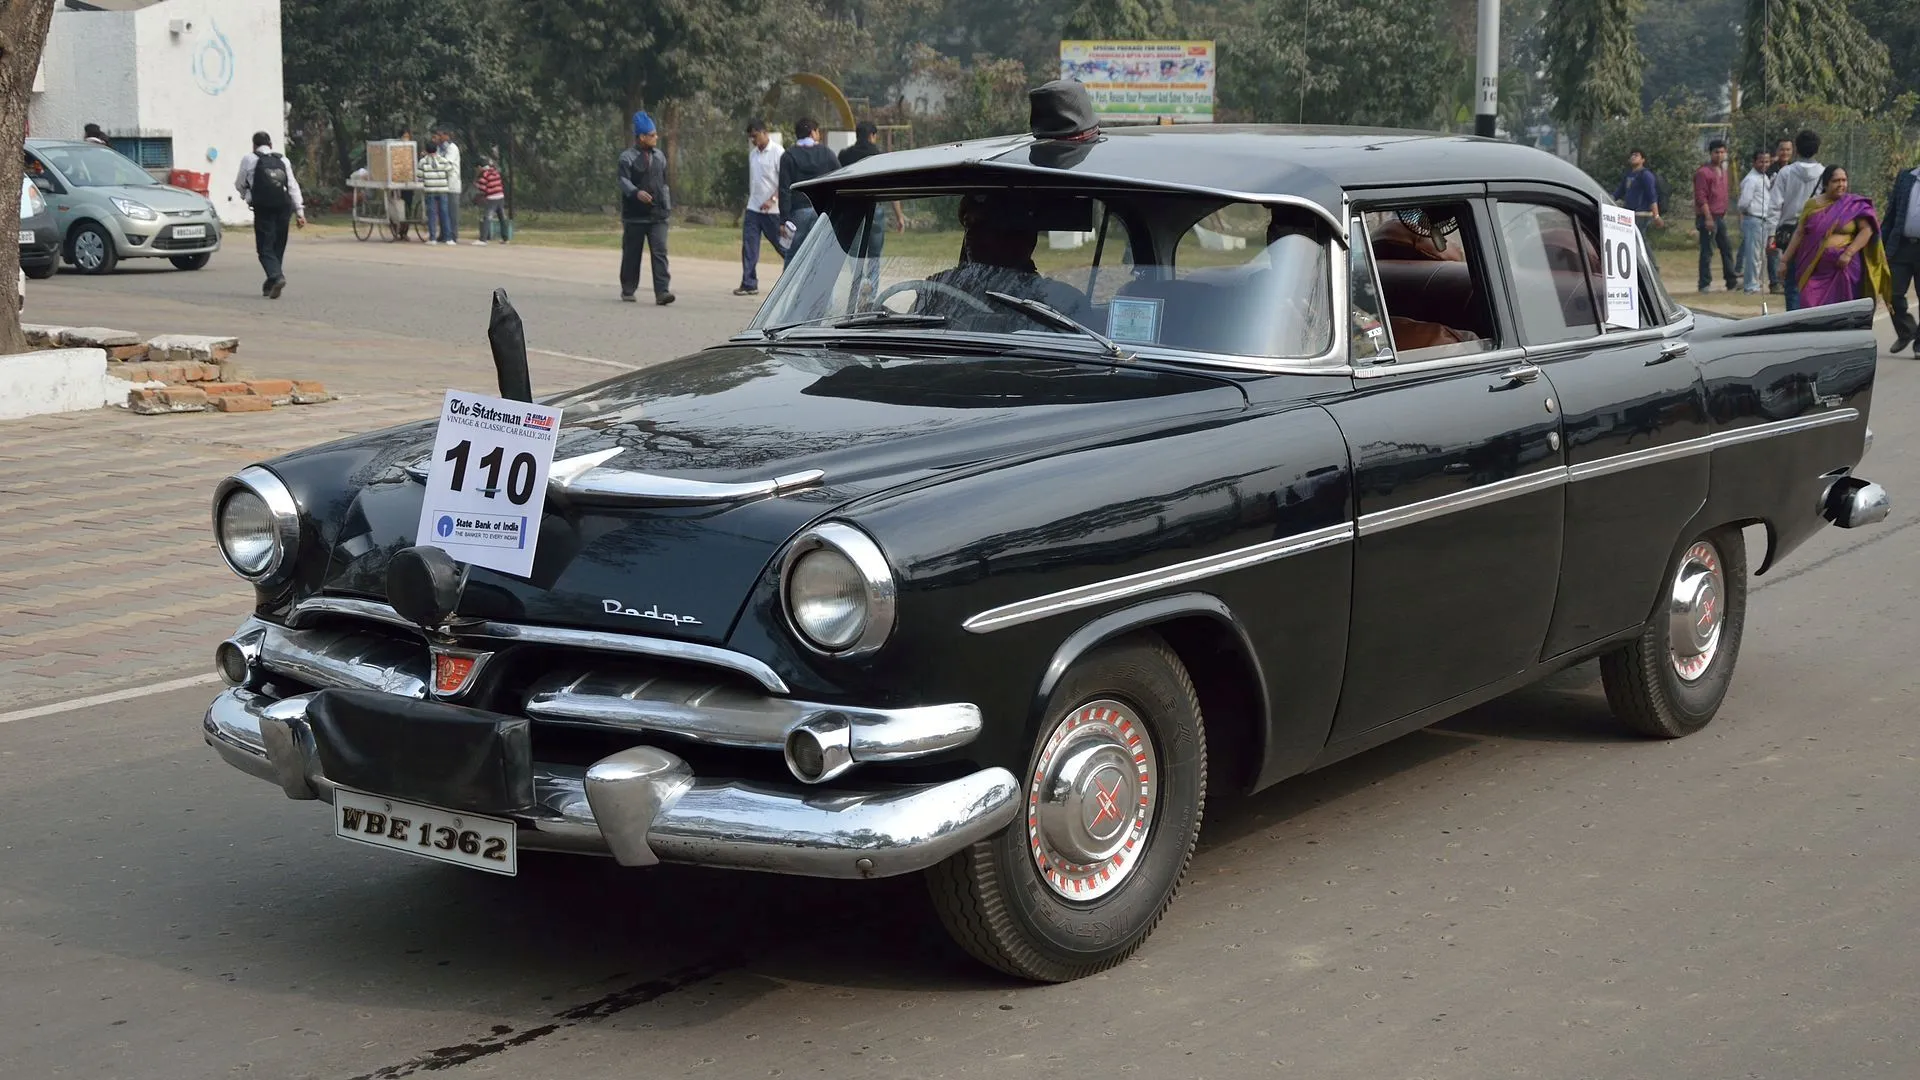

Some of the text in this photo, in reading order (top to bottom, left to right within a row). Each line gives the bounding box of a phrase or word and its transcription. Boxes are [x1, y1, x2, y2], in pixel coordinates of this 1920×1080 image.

[450, 399, 521, 425] The Statesman
[447, 415, 474, 427] VINTAGE
[481, 422, 505, 433] CLASSIC
[506, 426, 519, 436] CAR
[537, 432, 551, 441] 2014
[445, 440, 536, 505] 110
[455, 518, 519, 531] State Bank of India
[602, 599, 702, 627] Dodge
[342, 807, 507, 862] WBE 1362
